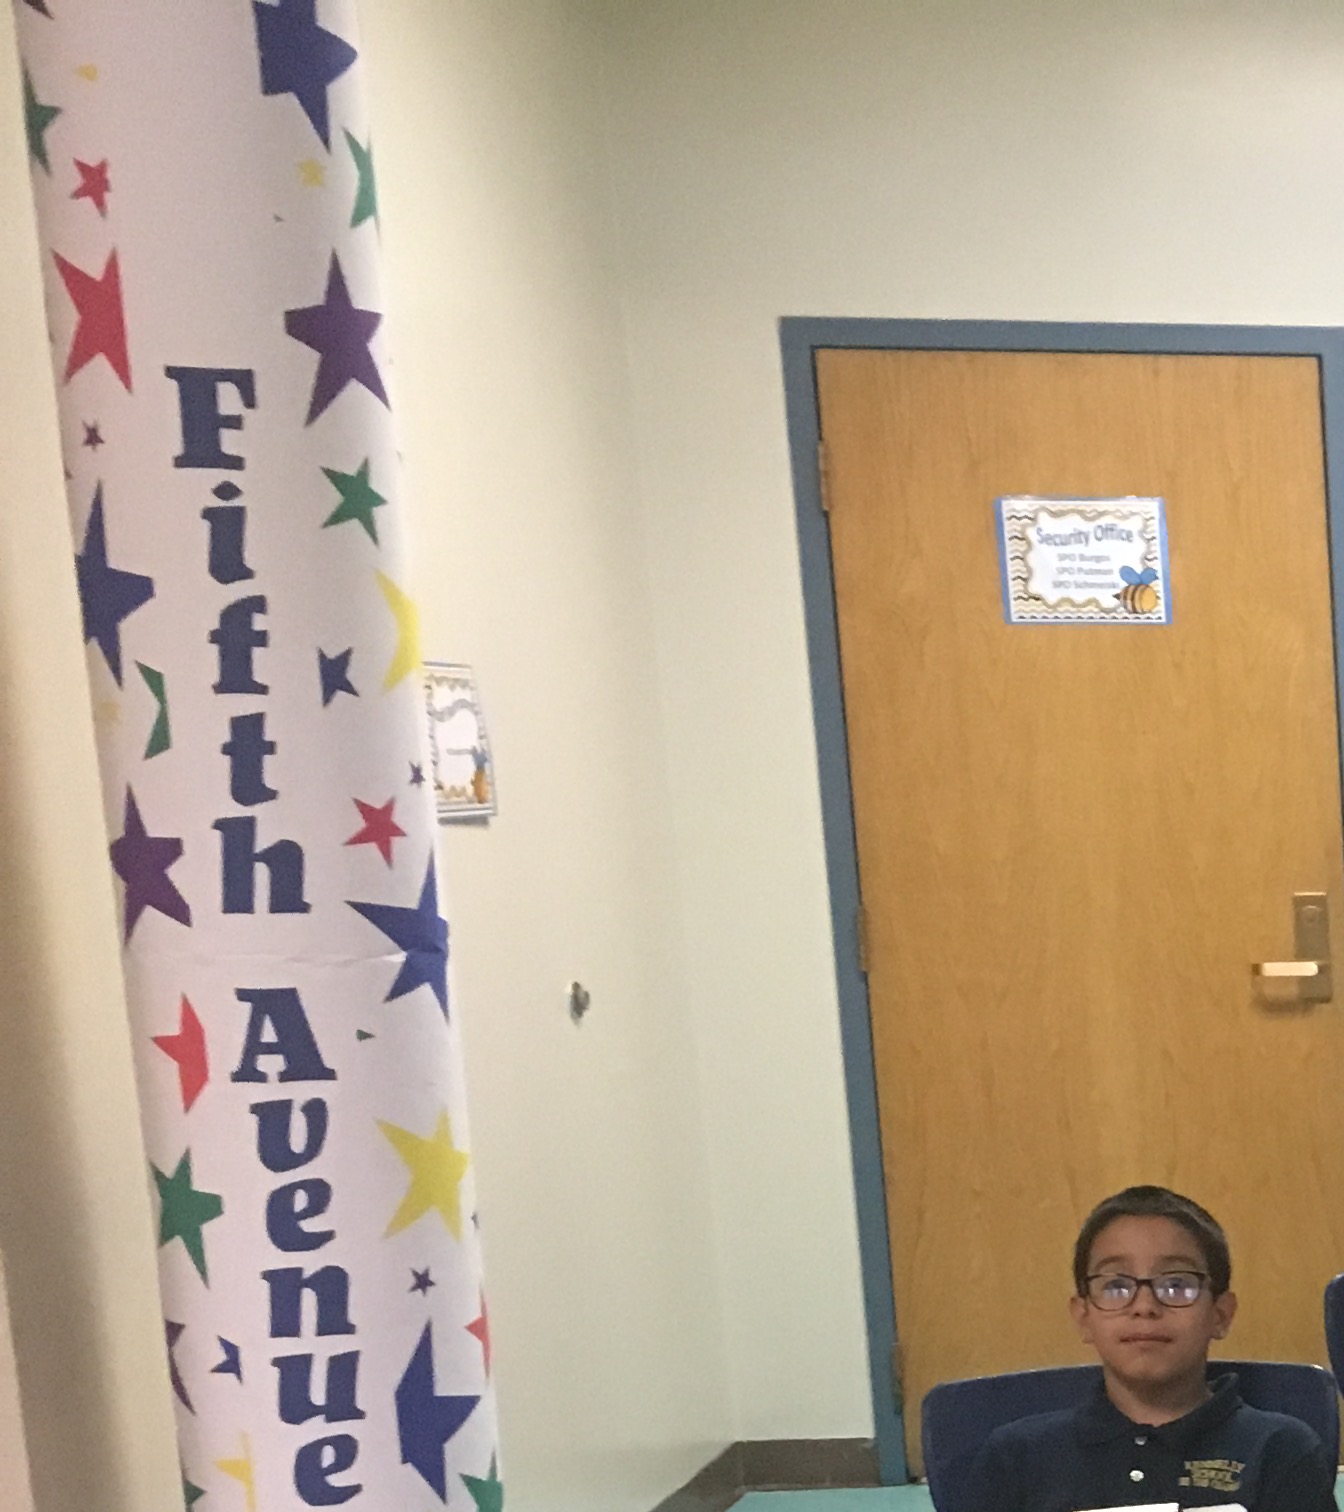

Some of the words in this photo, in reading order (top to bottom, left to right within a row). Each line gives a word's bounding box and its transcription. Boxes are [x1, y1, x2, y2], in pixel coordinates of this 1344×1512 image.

[164, 365, 312, 916] Fifth
[1036, 527, 1090, 547] Security
[1094, 523, 1133, 543] Office
[228, 986, 366, 1510] Avenue
